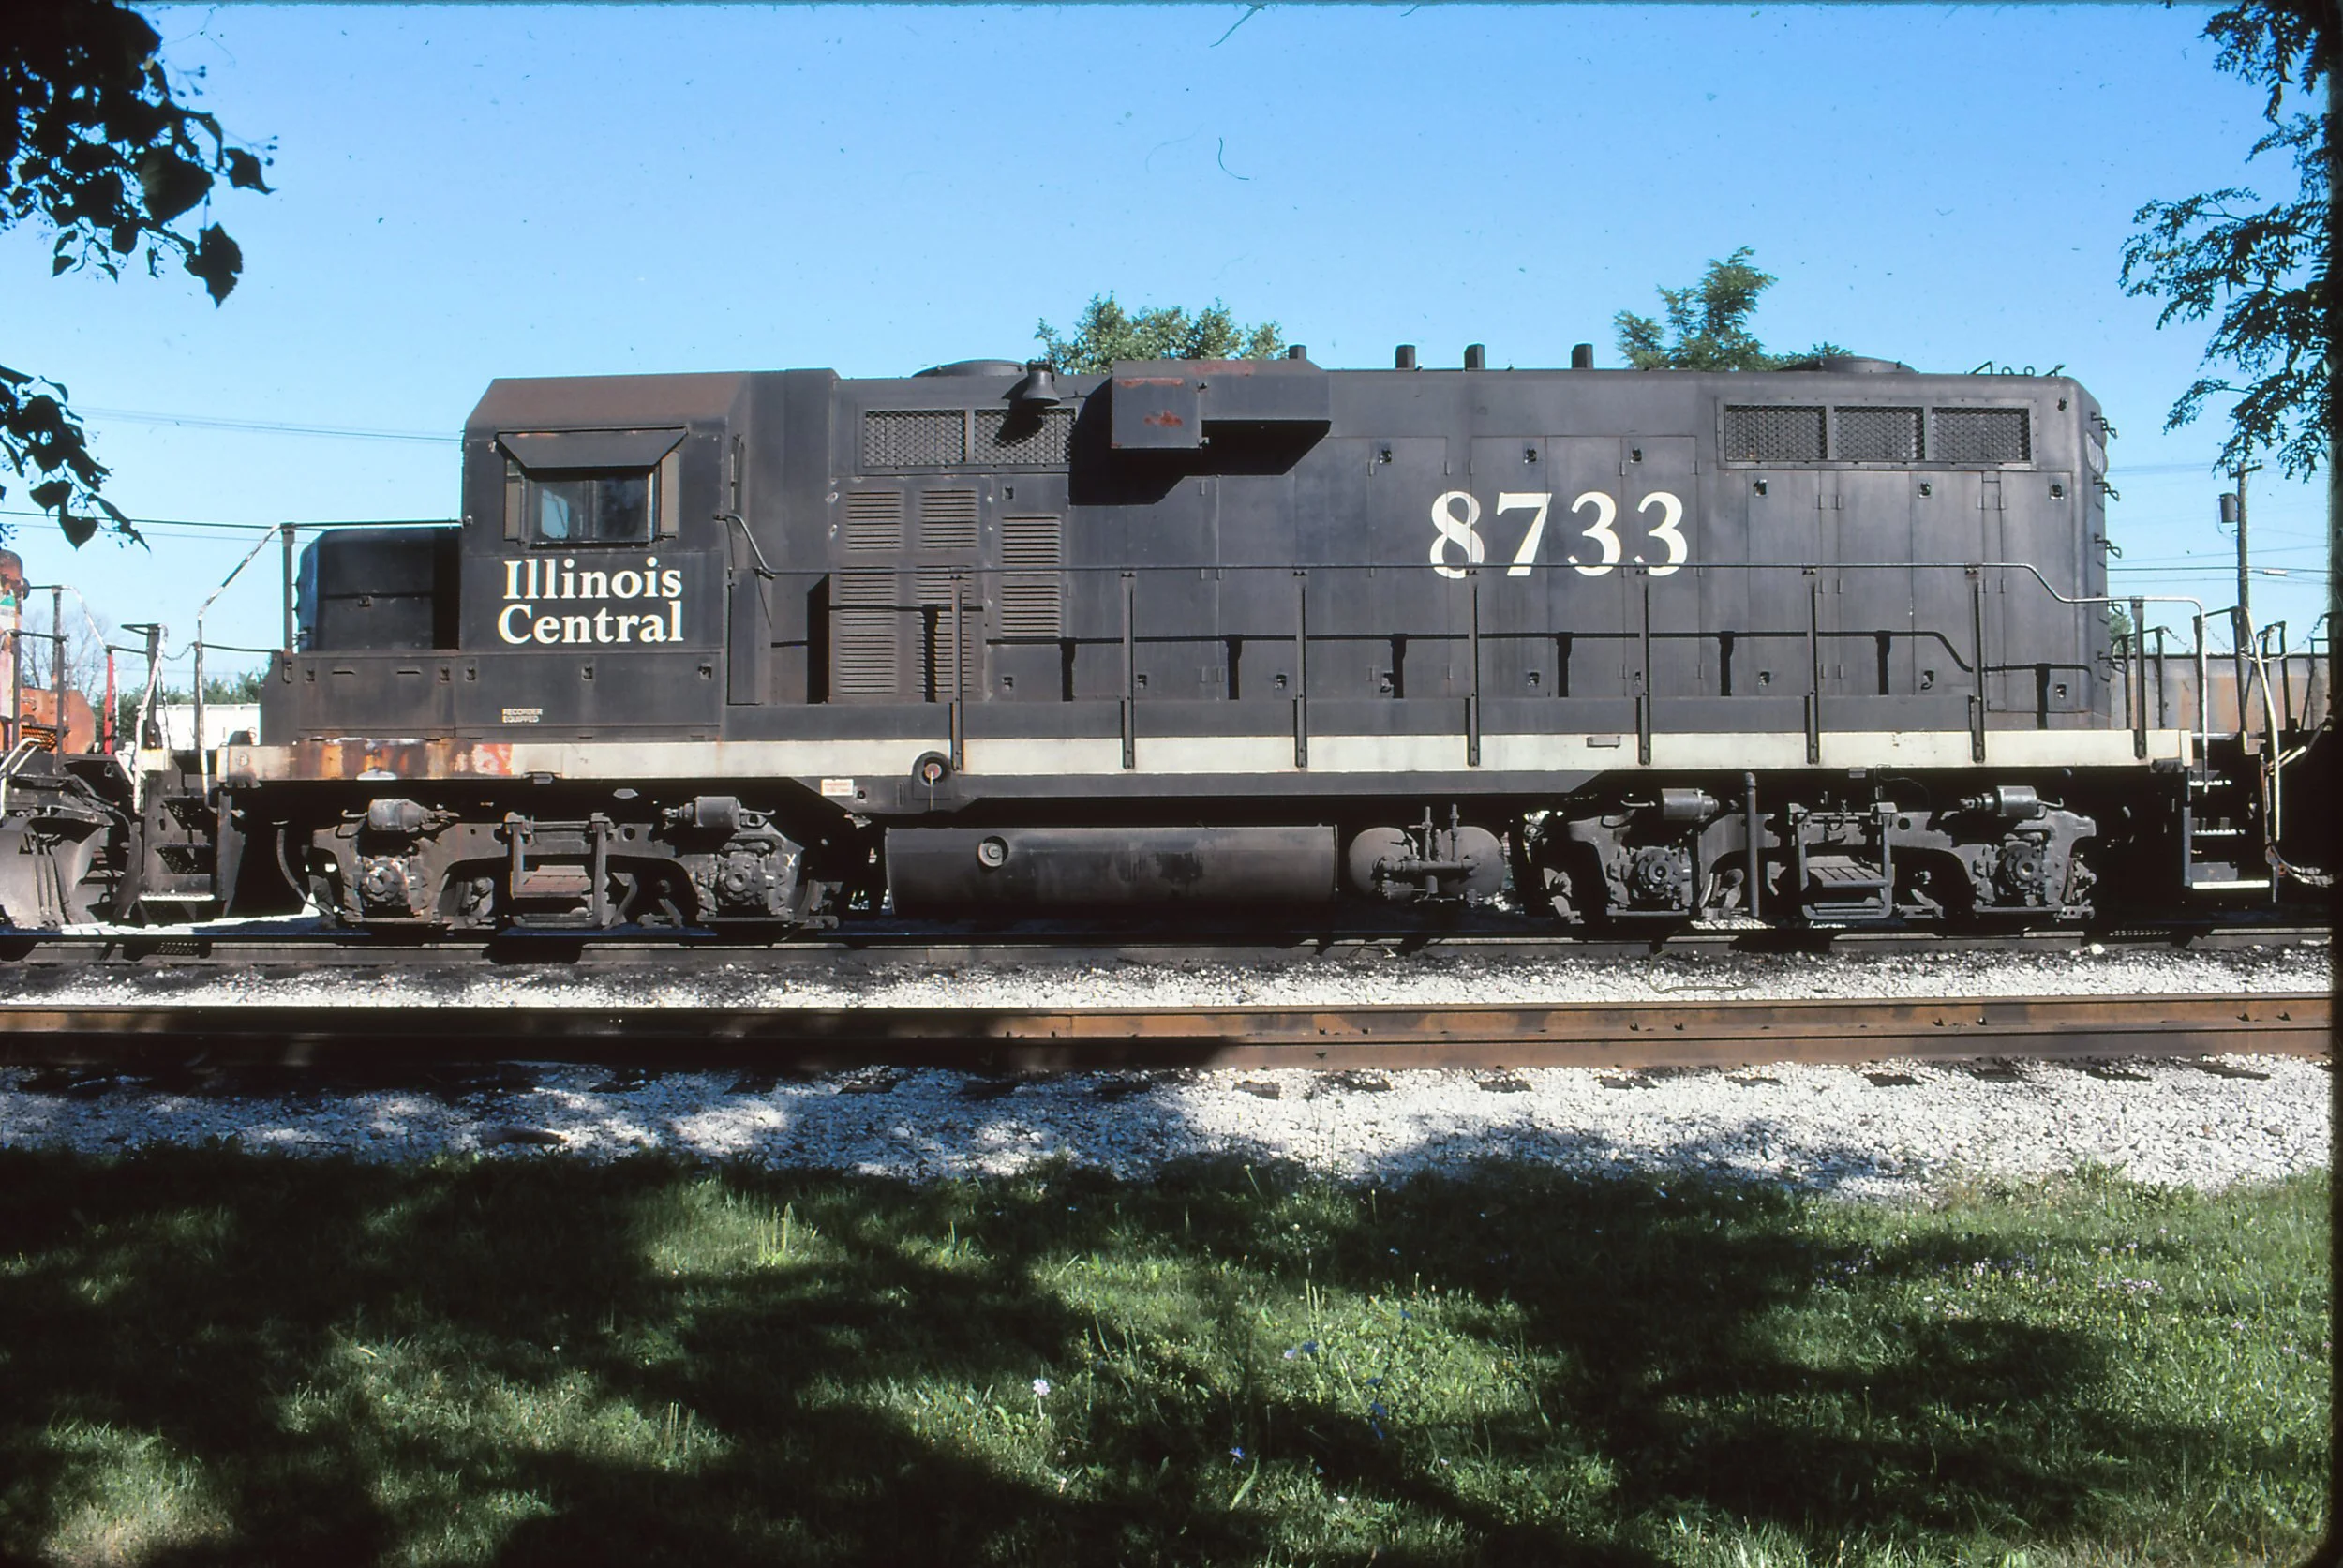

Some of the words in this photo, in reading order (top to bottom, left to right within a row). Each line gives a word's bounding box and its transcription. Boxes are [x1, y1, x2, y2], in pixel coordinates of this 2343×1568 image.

[1430, 491, 1687, 578] 8733
[503, 557, 682, 599] Illinois
[498, 601, 684, 644] Central
